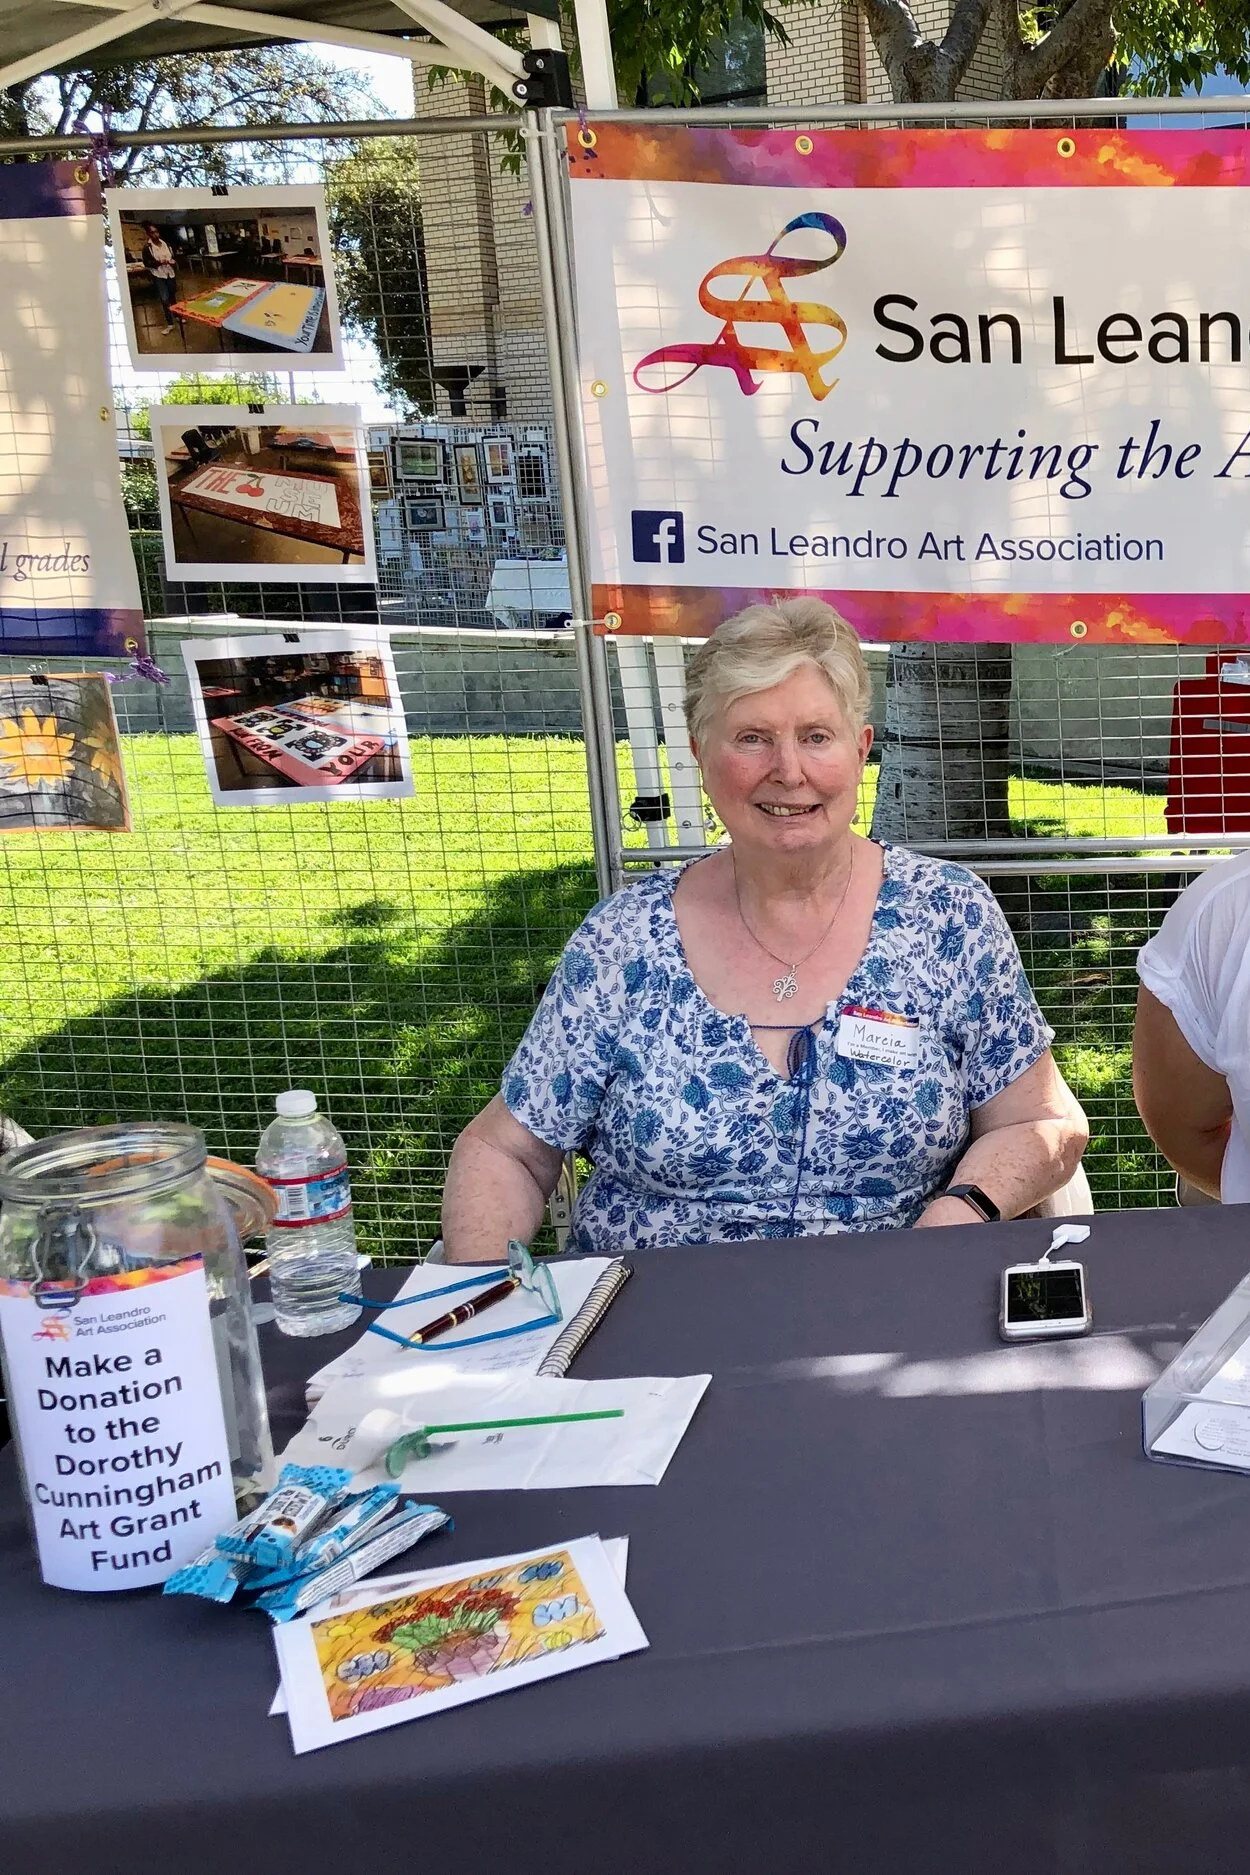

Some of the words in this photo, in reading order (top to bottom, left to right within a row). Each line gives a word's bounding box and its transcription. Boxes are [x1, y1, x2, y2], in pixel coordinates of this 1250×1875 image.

[872, 293, 1022, 365] San
[781, 417, 1099, 499] Supporting
[1115, 419, 1201, 480] the
[13, 542, 90, 581] grades
[697, 525, 760, 557] San
[771, 527, 907, 560] Leandro
[918, 531, 966, 561] Art
[975, 531, 1165, 563] Association
[319, 741, 379, 776] YOUR
[853, 1024, 906, 1048] Marcia
[73, 1316, 97, 1326] San
[100, 1305, 151, 1323] Leandro
[75, 1326, 93, 1337] Art
[97, 1312, 167, 1335] Association
[45, 1354, 132, 1379] Make
[144, 1348, 163, 1366] a
[37, 1375, 182, 1411] Donation
[65, 1423, 95, 1443] to
[105, 1416, 160, 1441] the
[55, 1442, 183, 1476] Dorothy
[35, 1460, 222, 1508] Cunningham
[60, 1518, 101, 1540] Art
[110, 1499, 202, 1538] Grant
[91, 1539, 172, 1571] Fund
